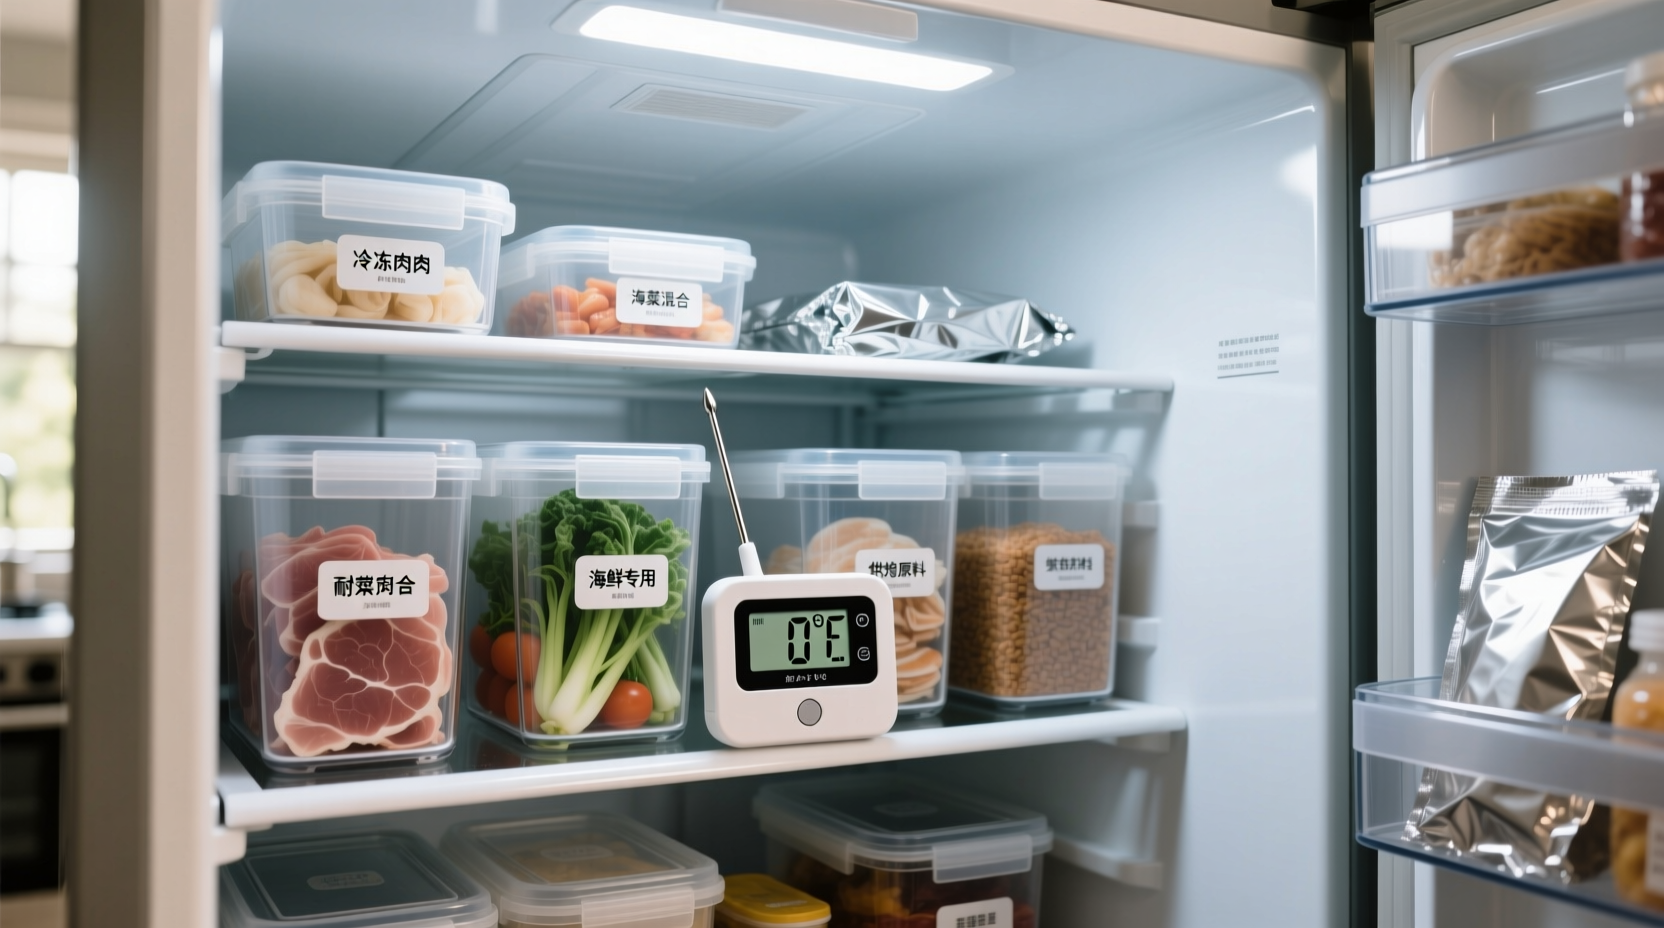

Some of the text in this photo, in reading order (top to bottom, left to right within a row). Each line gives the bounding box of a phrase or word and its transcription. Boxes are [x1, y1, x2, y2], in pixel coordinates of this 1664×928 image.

[353, 248, 430, 275] 冷冻肉肉
[588, 567, 656, 590] 海鲜专用
